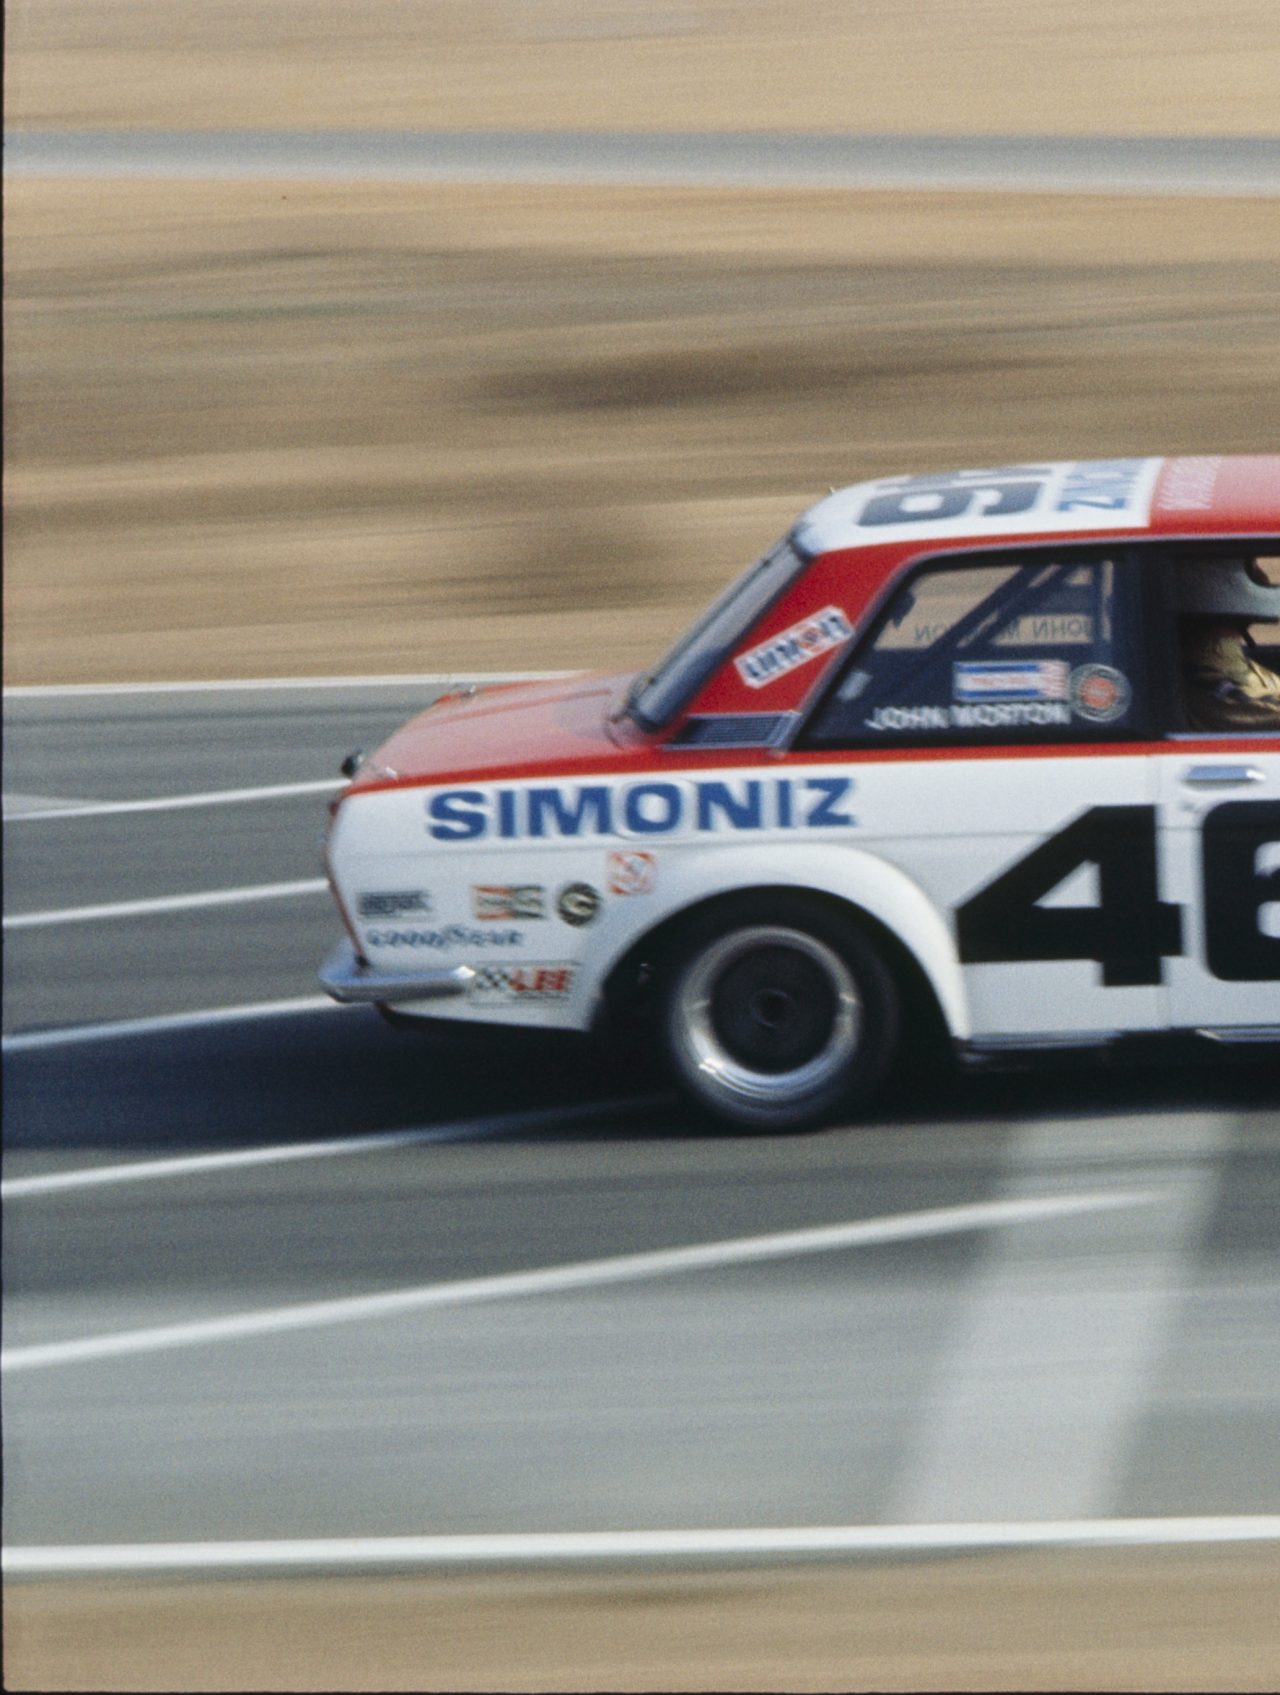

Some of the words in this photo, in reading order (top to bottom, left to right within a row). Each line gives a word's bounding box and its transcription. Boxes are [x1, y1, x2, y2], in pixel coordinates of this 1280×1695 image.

[865, 706, 949, 730] JOHN
[950, 702, 1071, 727] MORTON
[427, 777, 855, 841] SIMONIZ
